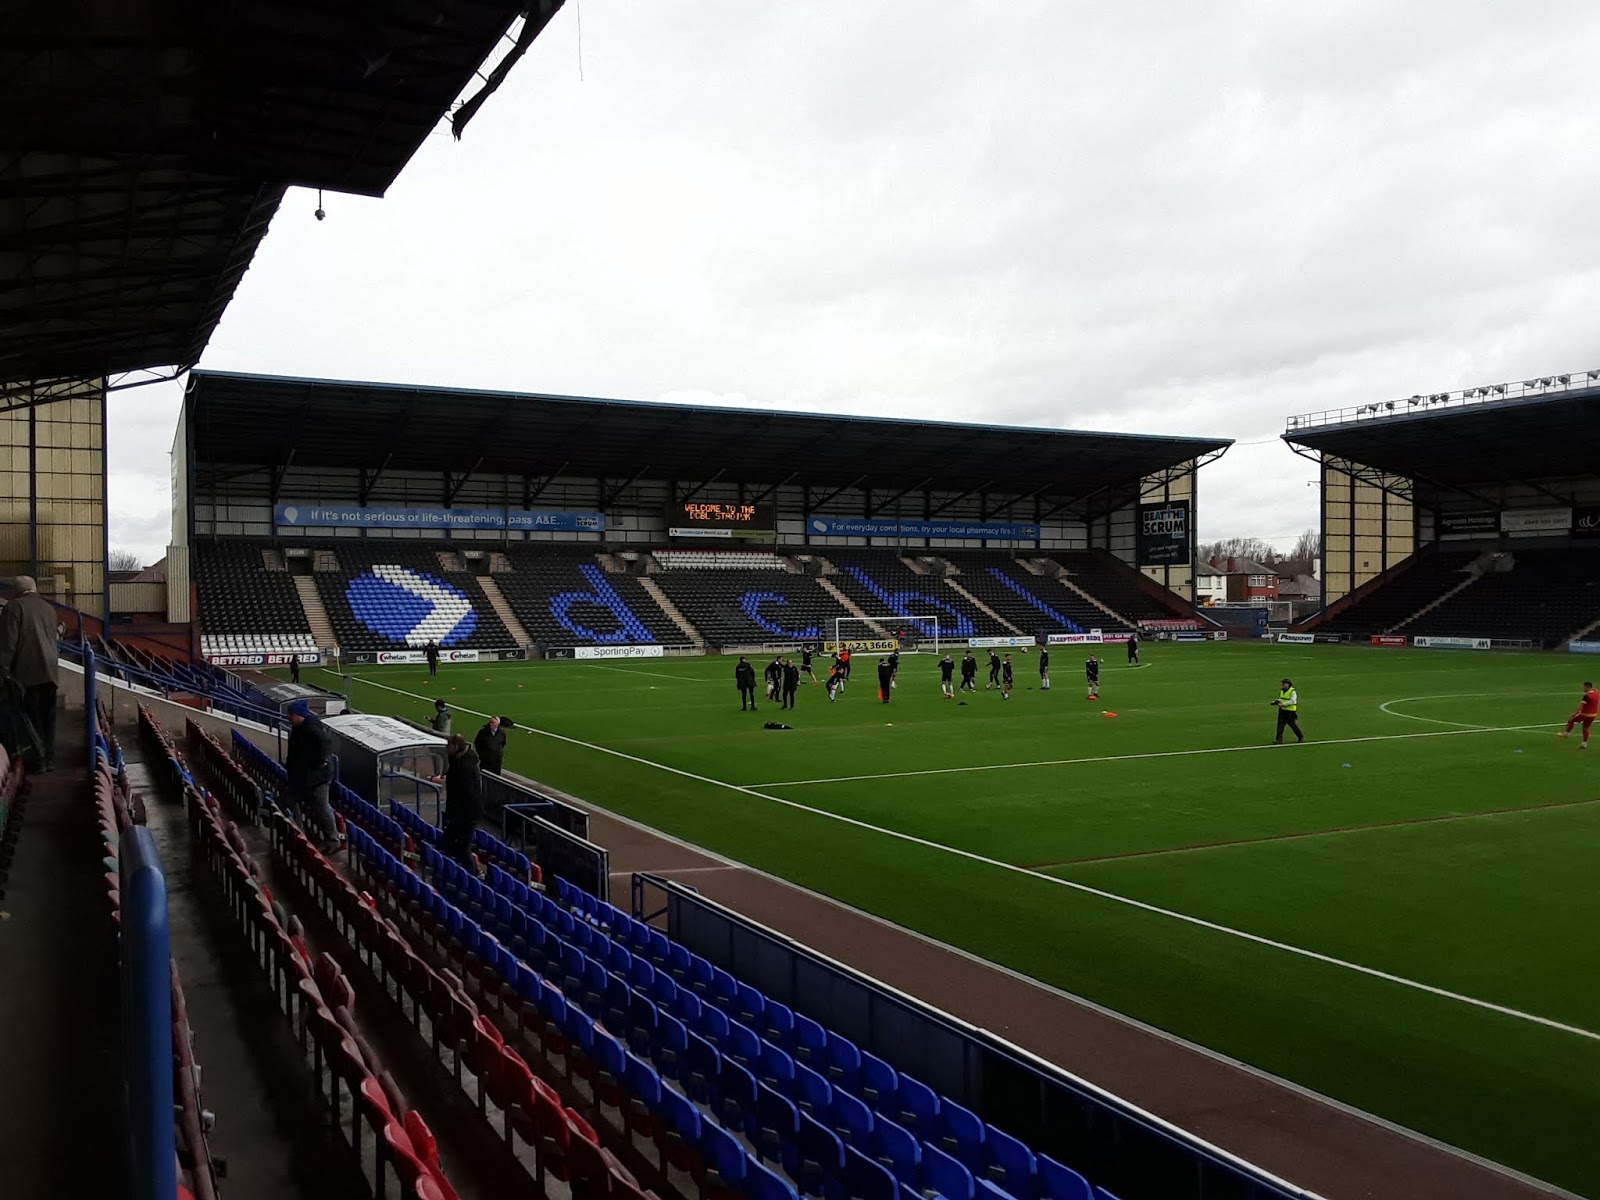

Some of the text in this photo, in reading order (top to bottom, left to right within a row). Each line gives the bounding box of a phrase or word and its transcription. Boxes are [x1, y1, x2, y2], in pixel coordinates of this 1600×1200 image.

[685, 504, 755, 514] WELCOME TO THE
[311, 510, 319, 520] If
[321, 510, 339, 520] it's
[341, 511, 361, 521] not
[364, 511, 406, 522] serious
[408, 513, 419, 522] or
[422, 512, 506, 526] life-threatening,
[508, 515, 533, 527] pass
[832, 522, 845, 531] For
[846, 523, 878, 533] everyday
[879, 523, 920, 533] condtions,
[921, 525, 932, 534] try
[932, 526, 948, 534] your
[949, 525, 965, 534] local
[966, 526, 999, 535] pharmacy
[1144, 520, 1184, 535] SCRUM
[1049, 634, 1101, 644] SLEEPTIGHT BEDS
[870, 641, 894, 650] 3666
[593, 646, 646, 658] SportingPay
[211, 654, 318, 666] BETFRED BETRED
